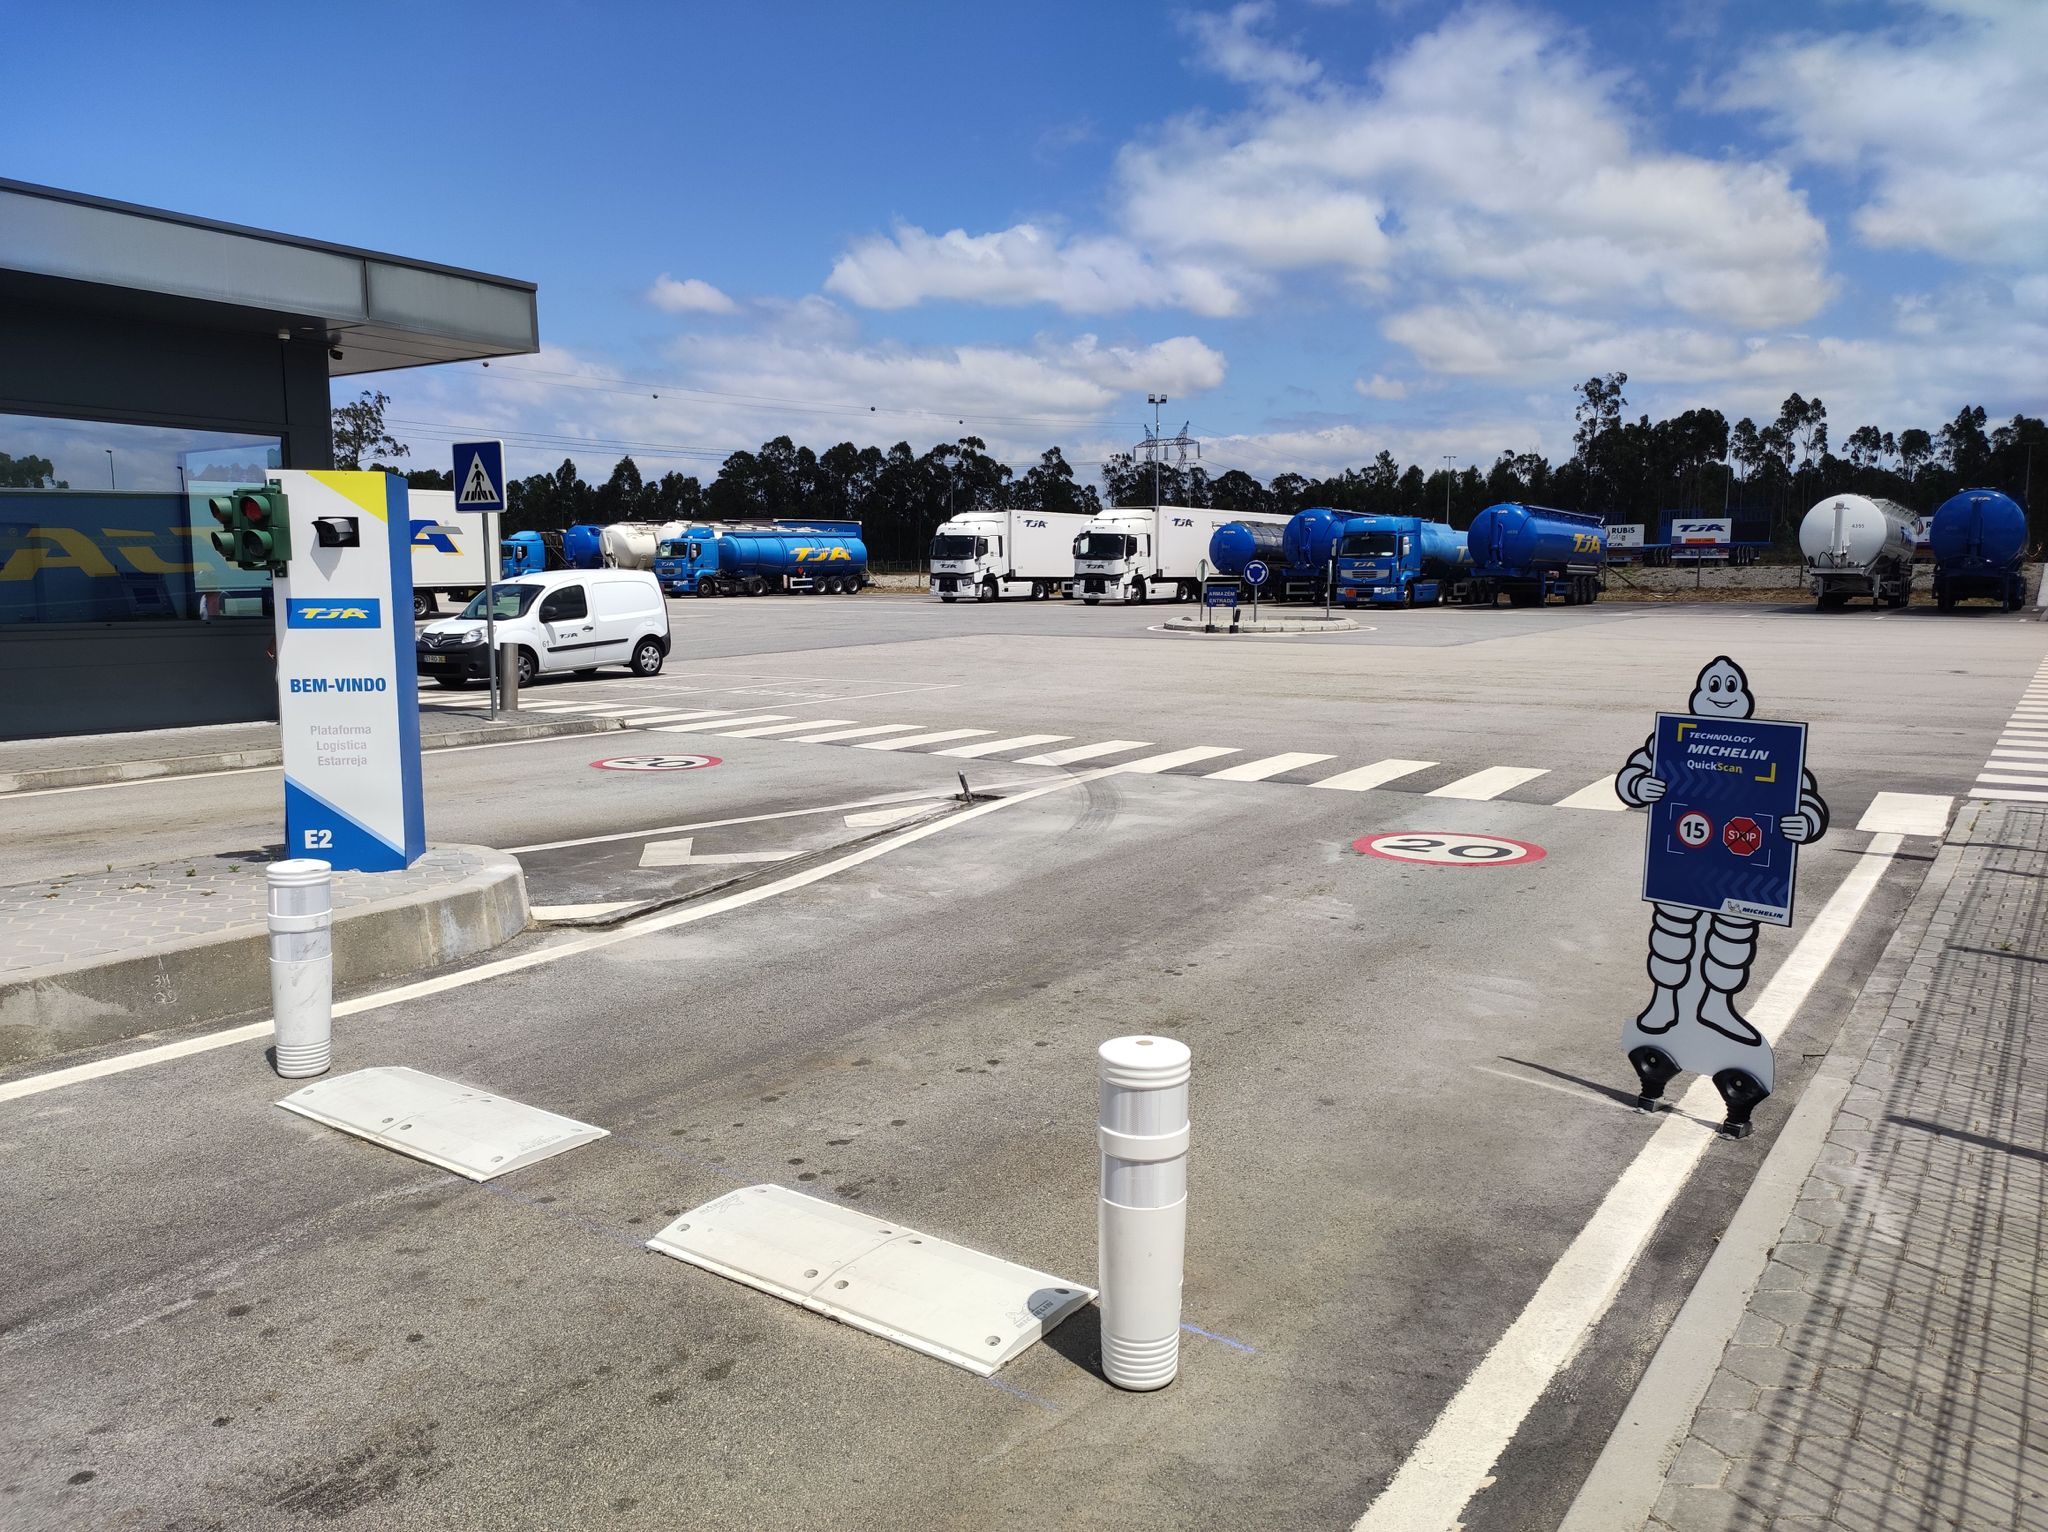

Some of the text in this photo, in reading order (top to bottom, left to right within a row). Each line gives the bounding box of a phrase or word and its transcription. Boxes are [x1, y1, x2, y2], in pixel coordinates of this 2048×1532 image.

[1023, 519, 1048, 528] TJA
[1171, 517, 1194, 527] TJA
[1678, 523, 1726, 533] TJA
[1574, 533, 1600, 553] TJA
[790, 546, 852, 562] TJA
[297, 607, 370, 619] TJA
[290, 677, 387, 693] BEM-VINDO
[310, 724, 372, 736] Plataforma
[1689, 731, 1756, 744] TECHNOLOGY
[1687, 743, 1770, 761] MICHELIN
[317, 754, 368, 767] Estarreja
[614, 757, 696, 768] 20
[1687, 758, 1743, 774] QuickScan
[1684, 821, 1705, 839] 15
[304, 829, 333, 850] E2
[1381, 838, 1513, 859] 20
[1741, 906, 1784, 919] MICHELIN
